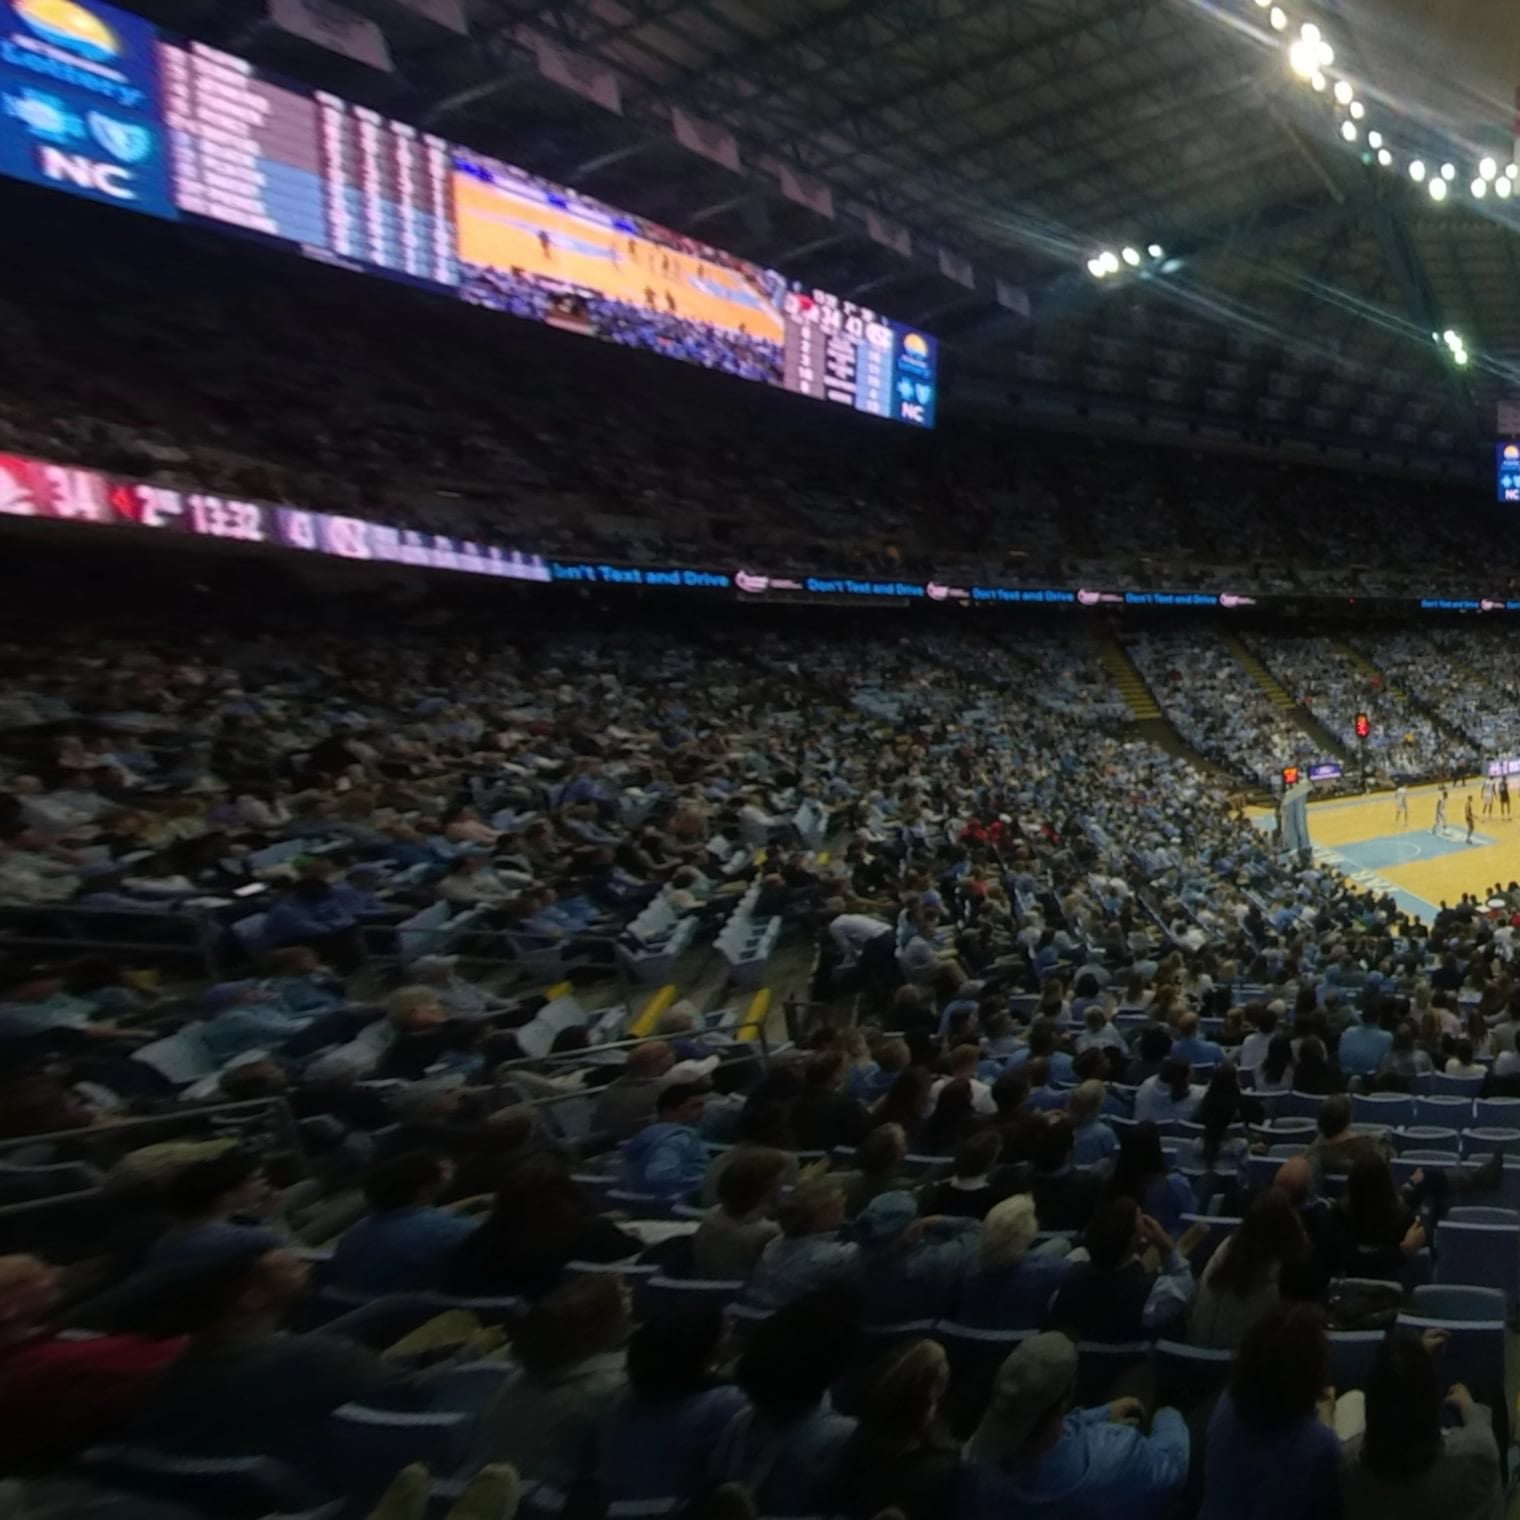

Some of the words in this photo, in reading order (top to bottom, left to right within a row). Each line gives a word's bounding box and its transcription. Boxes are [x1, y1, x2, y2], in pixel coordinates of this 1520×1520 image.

[38, 144, 138, 200] NC
[901, 402, 925, 423] NC
[598, 565, 643, 583] Text
[646, 571, 681, 585] and
[683, 570, 730, 588] Drive
